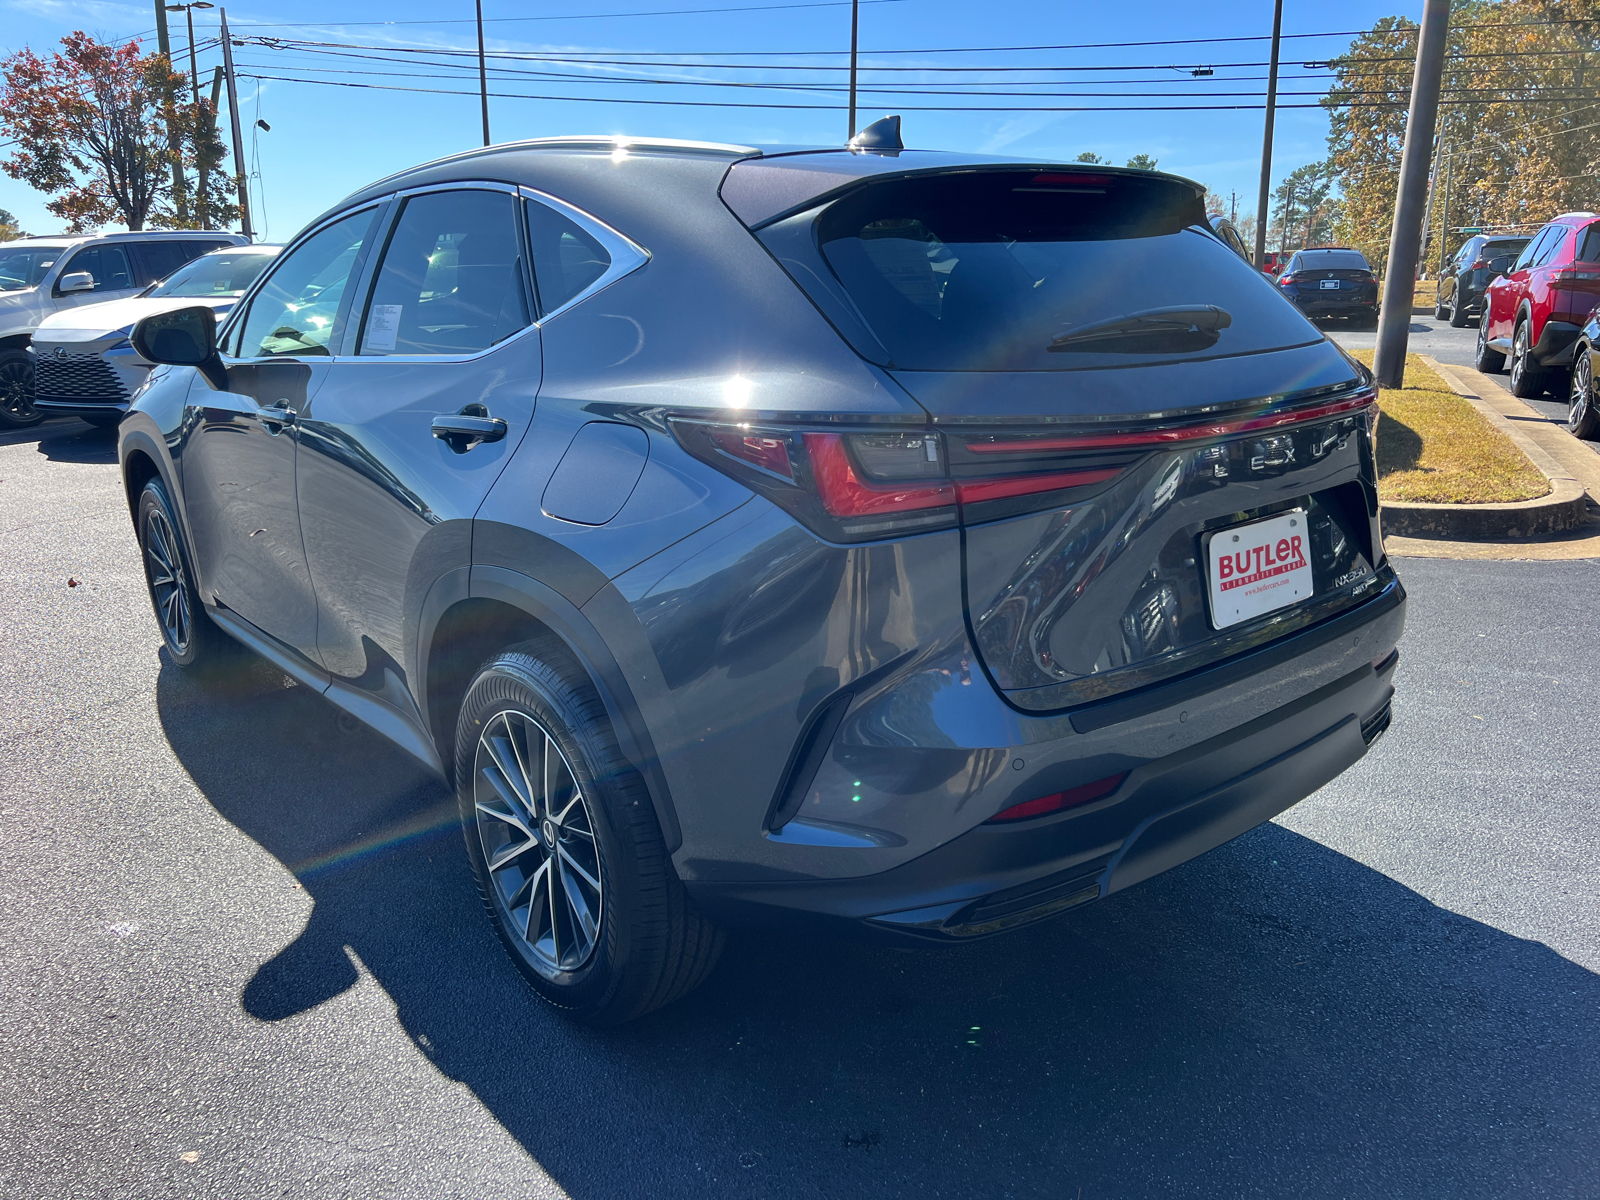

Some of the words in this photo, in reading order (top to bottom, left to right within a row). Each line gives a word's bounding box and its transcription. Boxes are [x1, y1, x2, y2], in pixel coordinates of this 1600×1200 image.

[1213, 434, 1348, 478] LEXUS
[1220, 567, 1275, 592] AUTOMOTIVE
[1281, 558, 1306, 573] GROUP
[1244, 579, 1290, 597] www.butlercars.com
[1352, 582, 1368, 597] AWD
